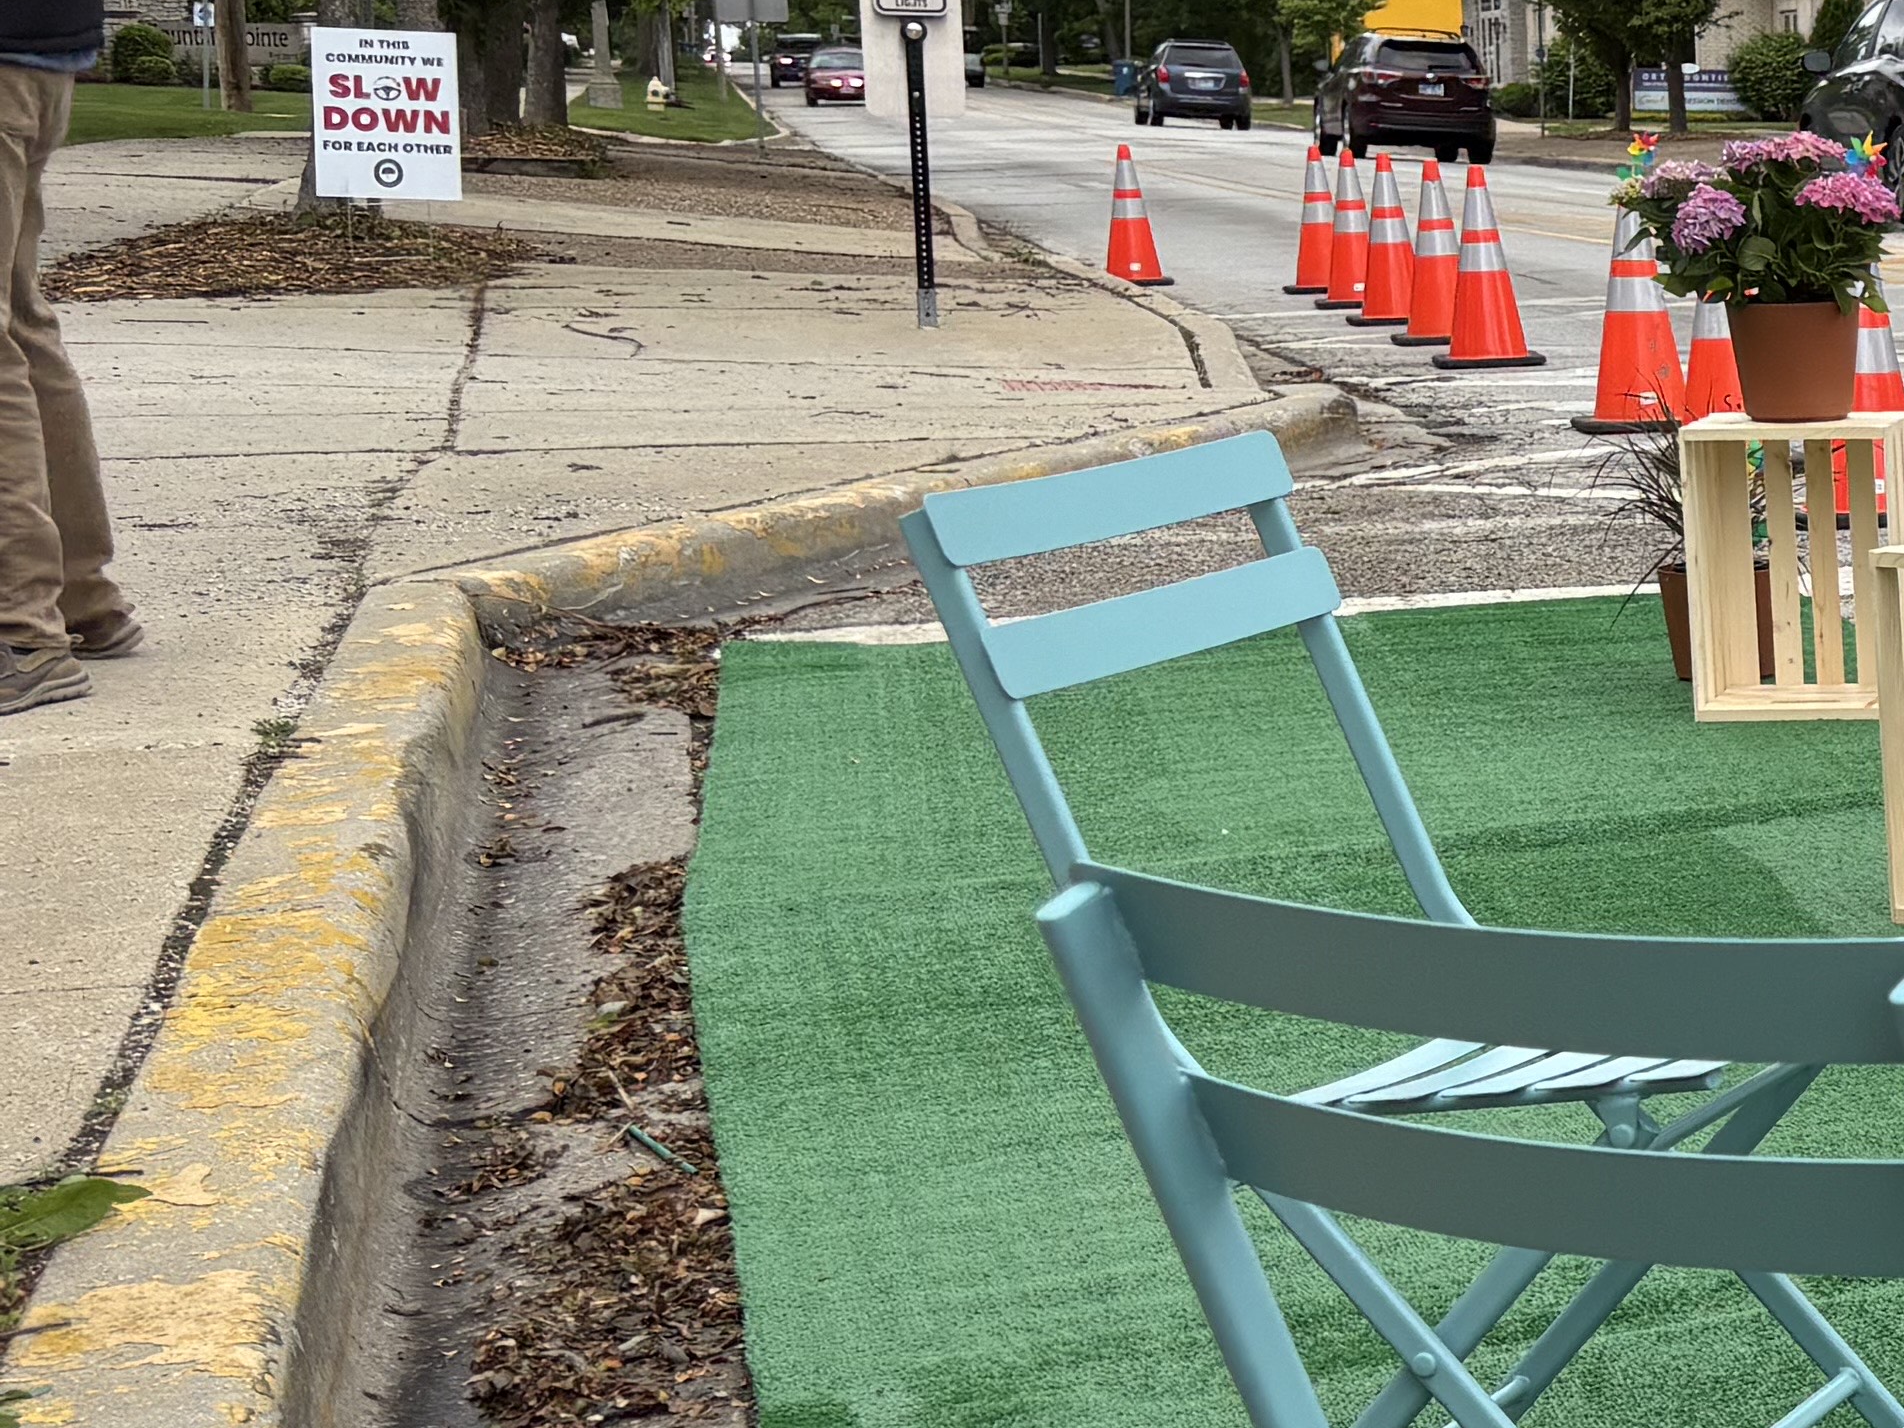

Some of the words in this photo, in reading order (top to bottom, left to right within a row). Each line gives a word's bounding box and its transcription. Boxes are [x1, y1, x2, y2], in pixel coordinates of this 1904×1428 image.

[895, 0, 927, 7] LIGHTS
[359, 39, 373, 48] IN
[378, 40, 409, 50] THIS
[326, 53, 416, 65] COMMUNITY
[421, 57, 443, 67] WE
[323, 106, 450, 134] DOWN
[323, 140, 352, 151] FOR
[357, 141, 398, 152] EACH
[403, 143, 452, 154] OTHER
